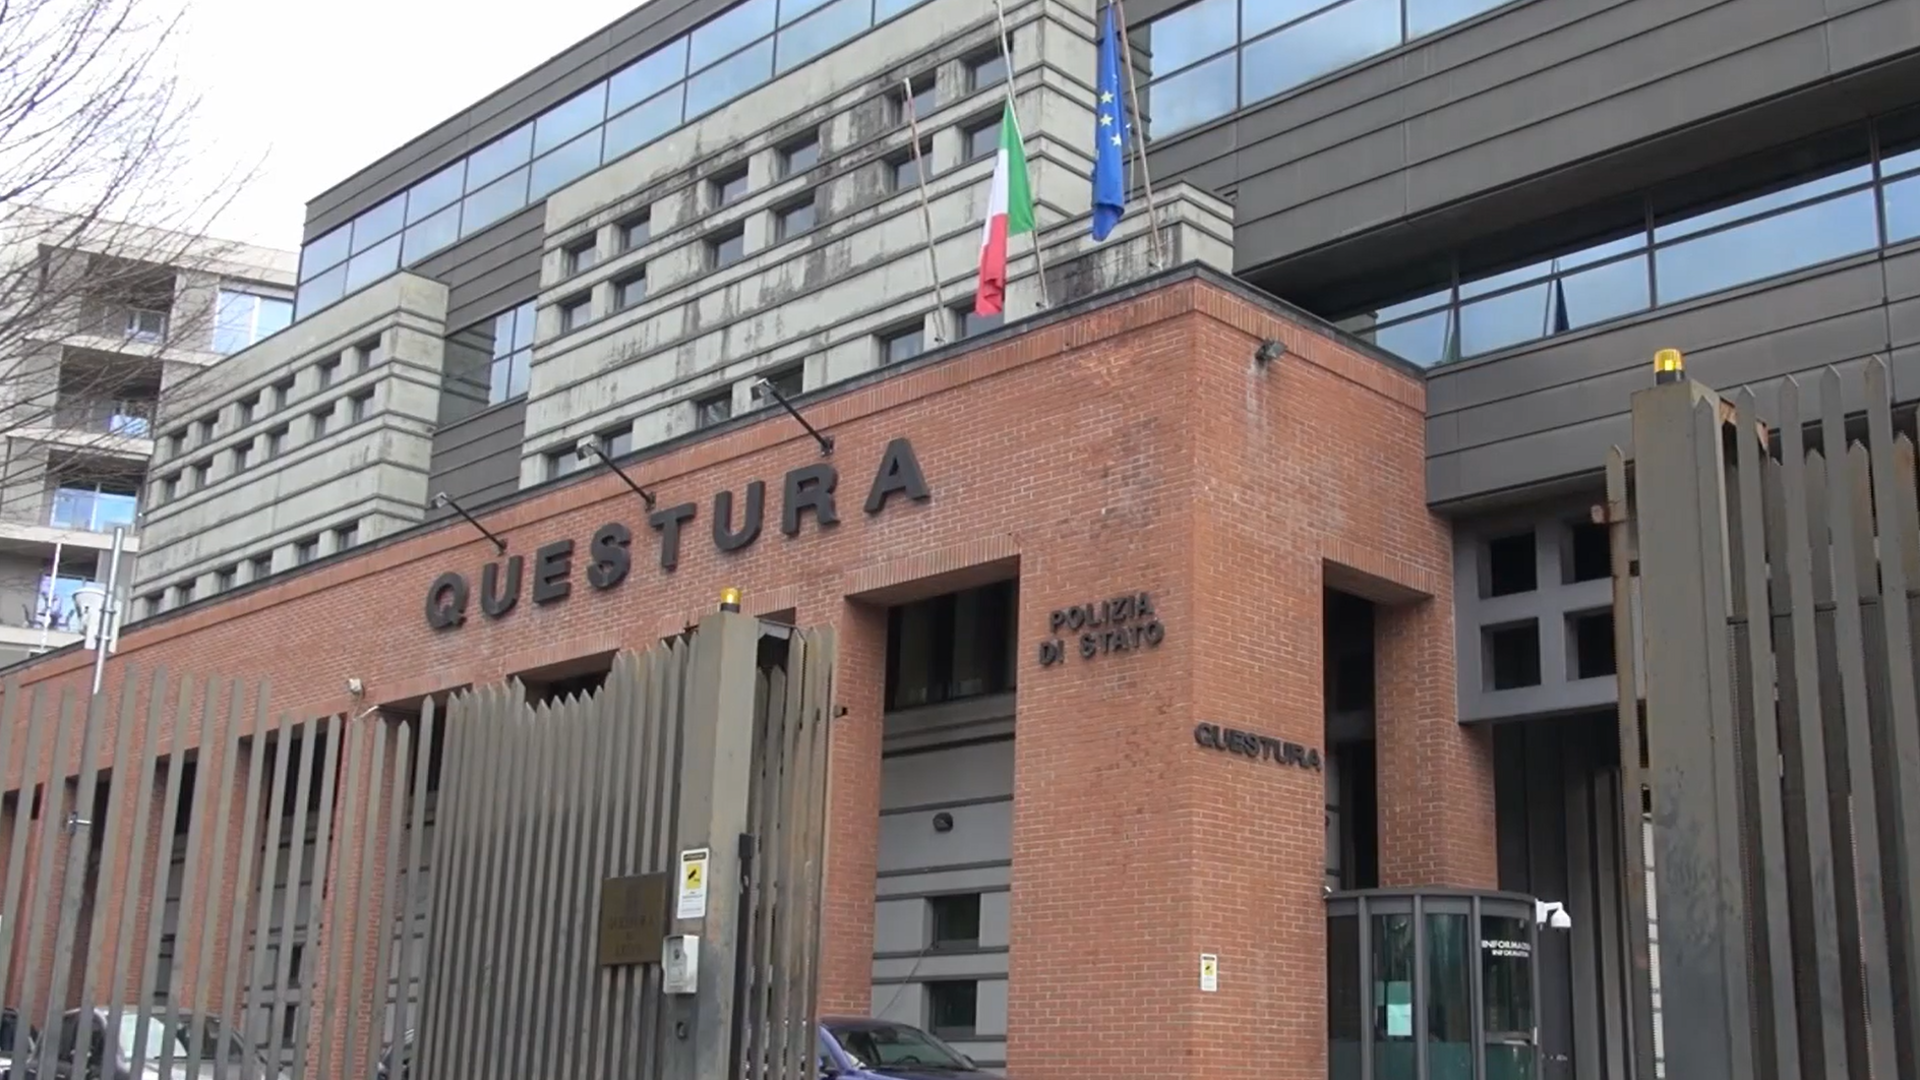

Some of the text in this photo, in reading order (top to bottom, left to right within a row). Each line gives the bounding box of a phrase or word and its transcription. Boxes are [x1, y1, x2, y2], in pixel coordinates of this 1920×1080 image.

[424, 436, 931, 630] QUESTURA
[1050, 592, 1154, 633] POLIZIA
[1038, 620, 1165, 667] DI STATO
[1194, 722, 1322, 772] QUESTURA
